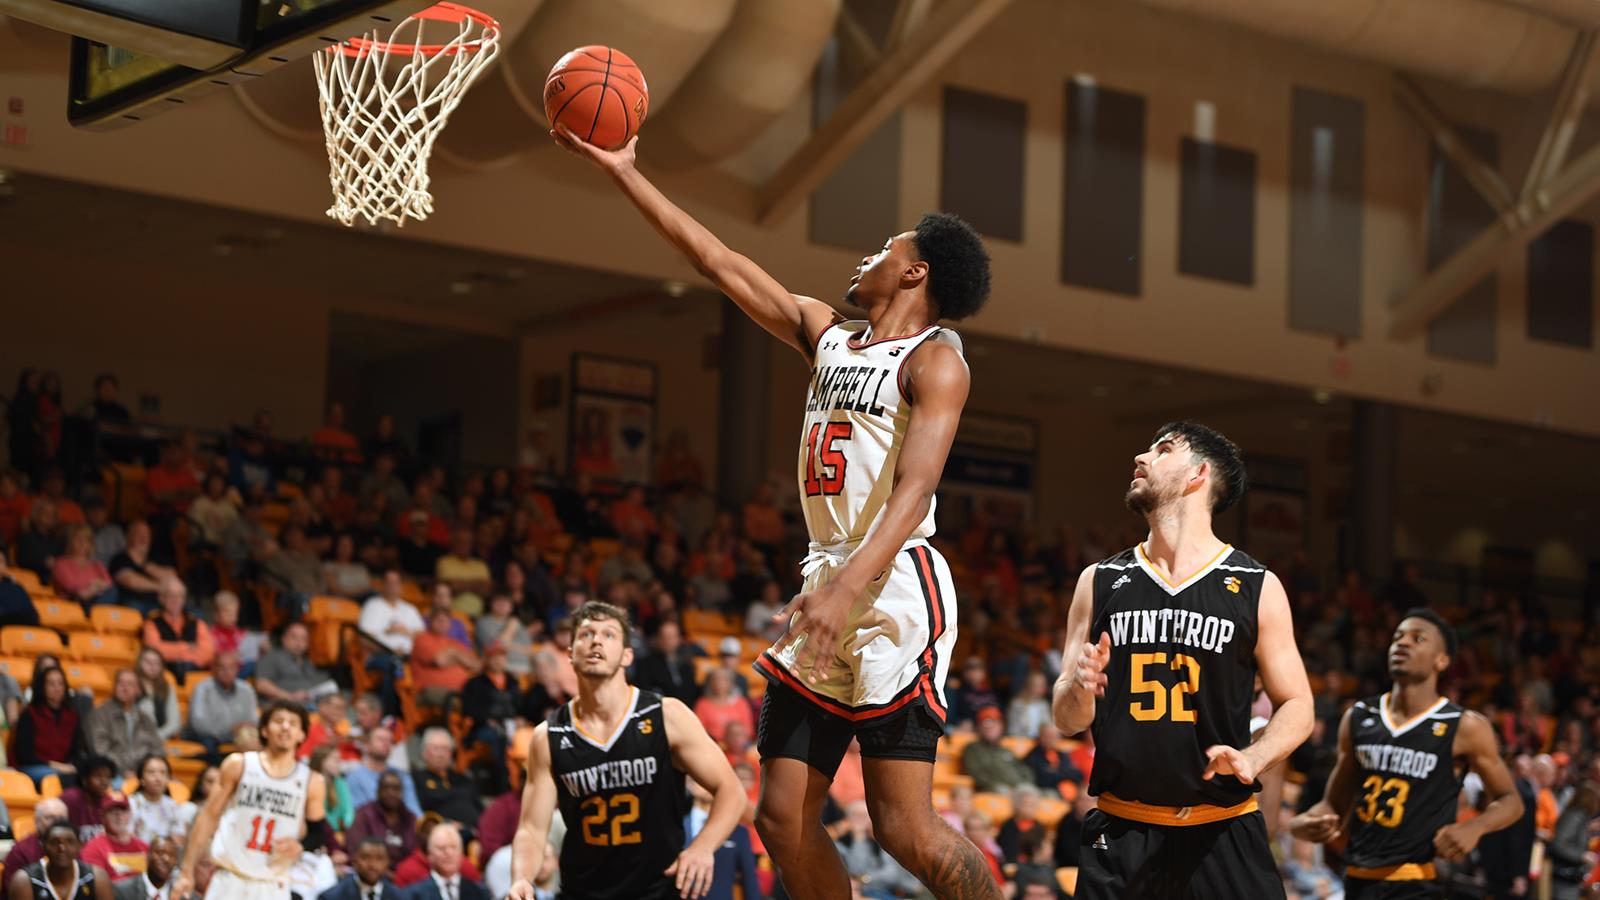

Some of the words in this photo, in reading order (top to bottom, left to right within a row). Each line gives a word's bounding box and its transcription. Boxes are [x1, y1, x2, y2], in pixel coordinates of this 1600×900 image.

[807, 366, 889, 417] AMPBELL
[804, 422, 853, 497] 15
[1110, 608, 1235, 654] WINTHROP
[1129, 652, 1201, 724] 52
[559, 756, 658, 798] WINTHROP
[1356, 775, 1410, 828] 33
[247, 815, 275, 853] 11
[581, 793, 642, 846] 22
